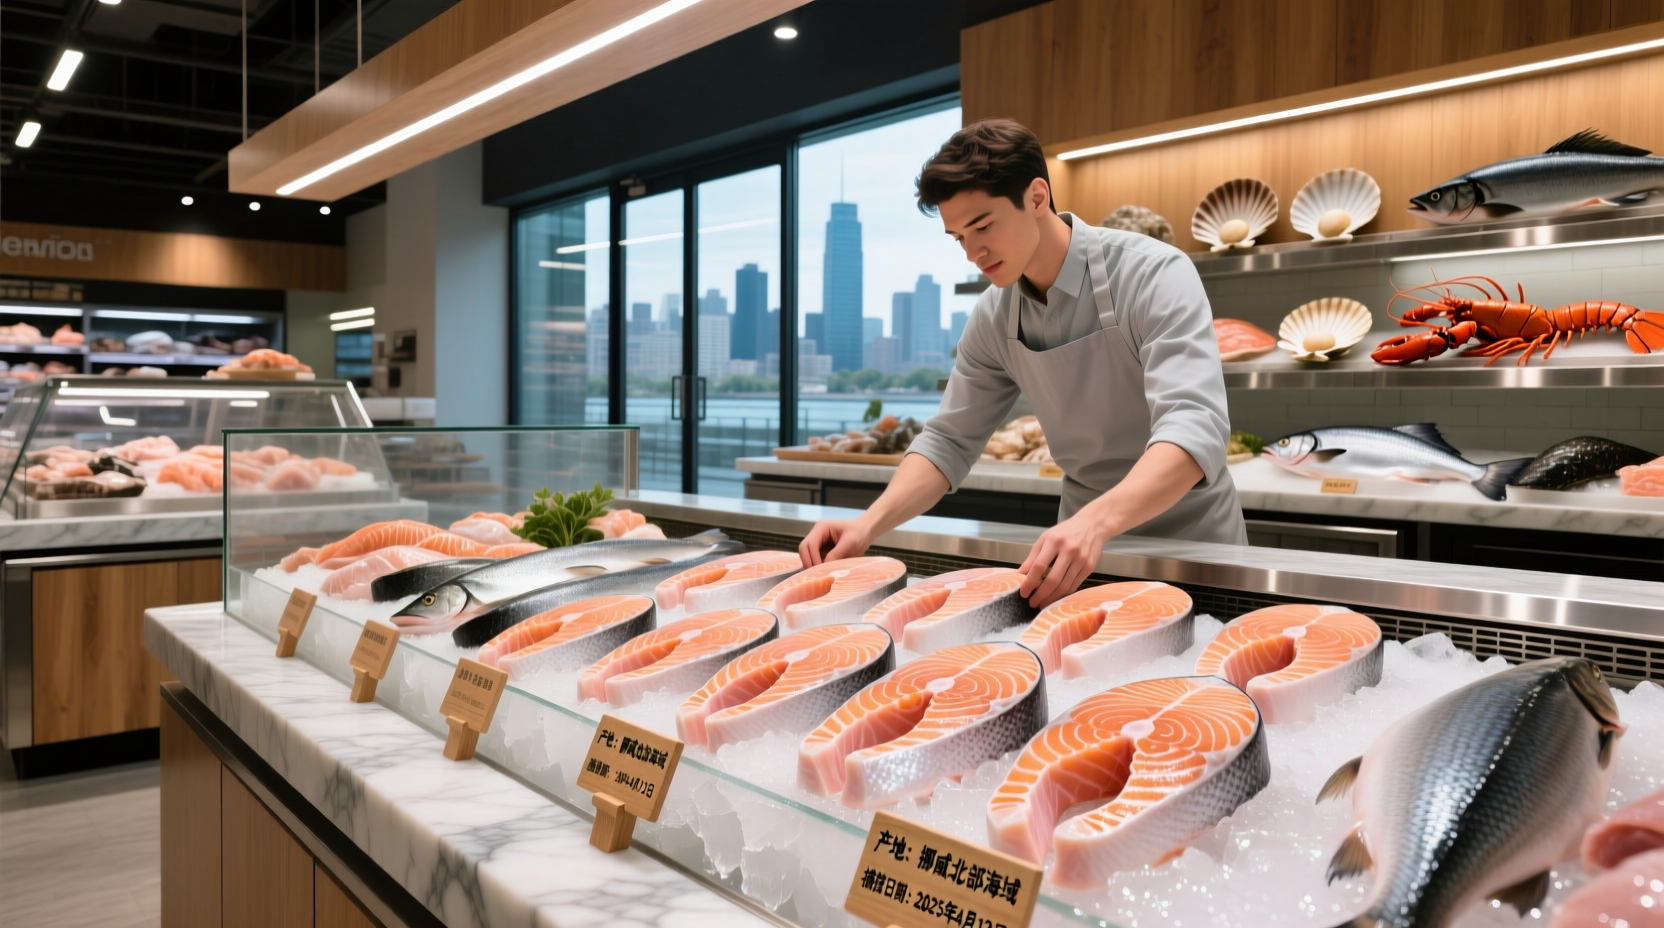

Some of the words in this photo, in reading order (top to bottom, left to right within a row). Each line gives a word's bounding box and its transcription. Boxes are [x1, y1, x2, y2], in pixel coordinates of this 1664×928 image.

[874, 829, 1022, 906] 产地：挪威北部海域
